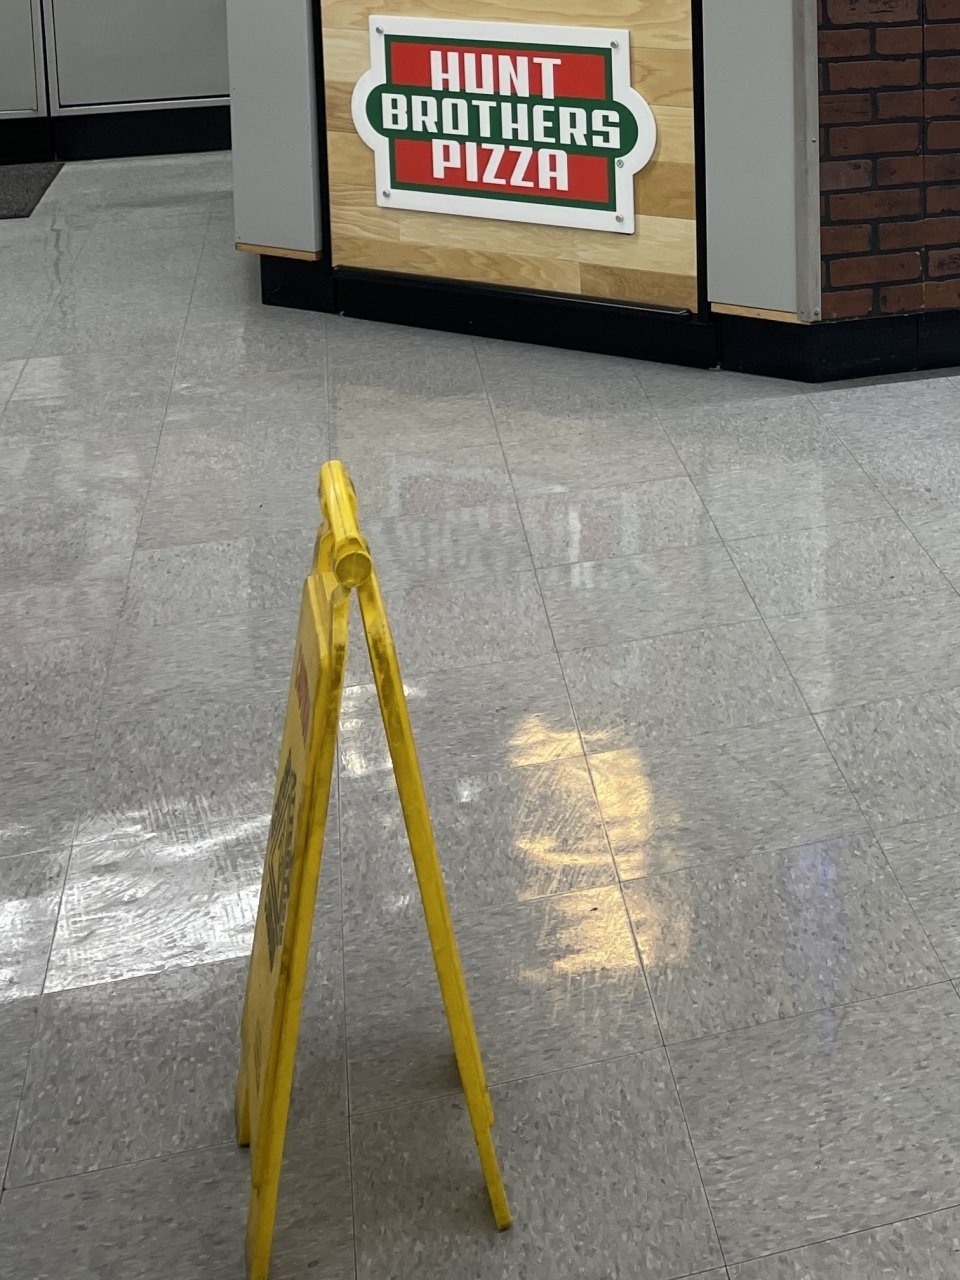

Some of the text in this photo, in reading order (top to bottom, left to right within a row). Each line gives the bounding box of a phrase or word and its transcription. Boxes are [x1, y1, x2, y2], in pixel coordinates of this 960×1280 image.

[430, 49, 562, 100] HUNT
[381, 92, 621, 150] BROTHERS
[432, 138, 570, 192] PIZZA
